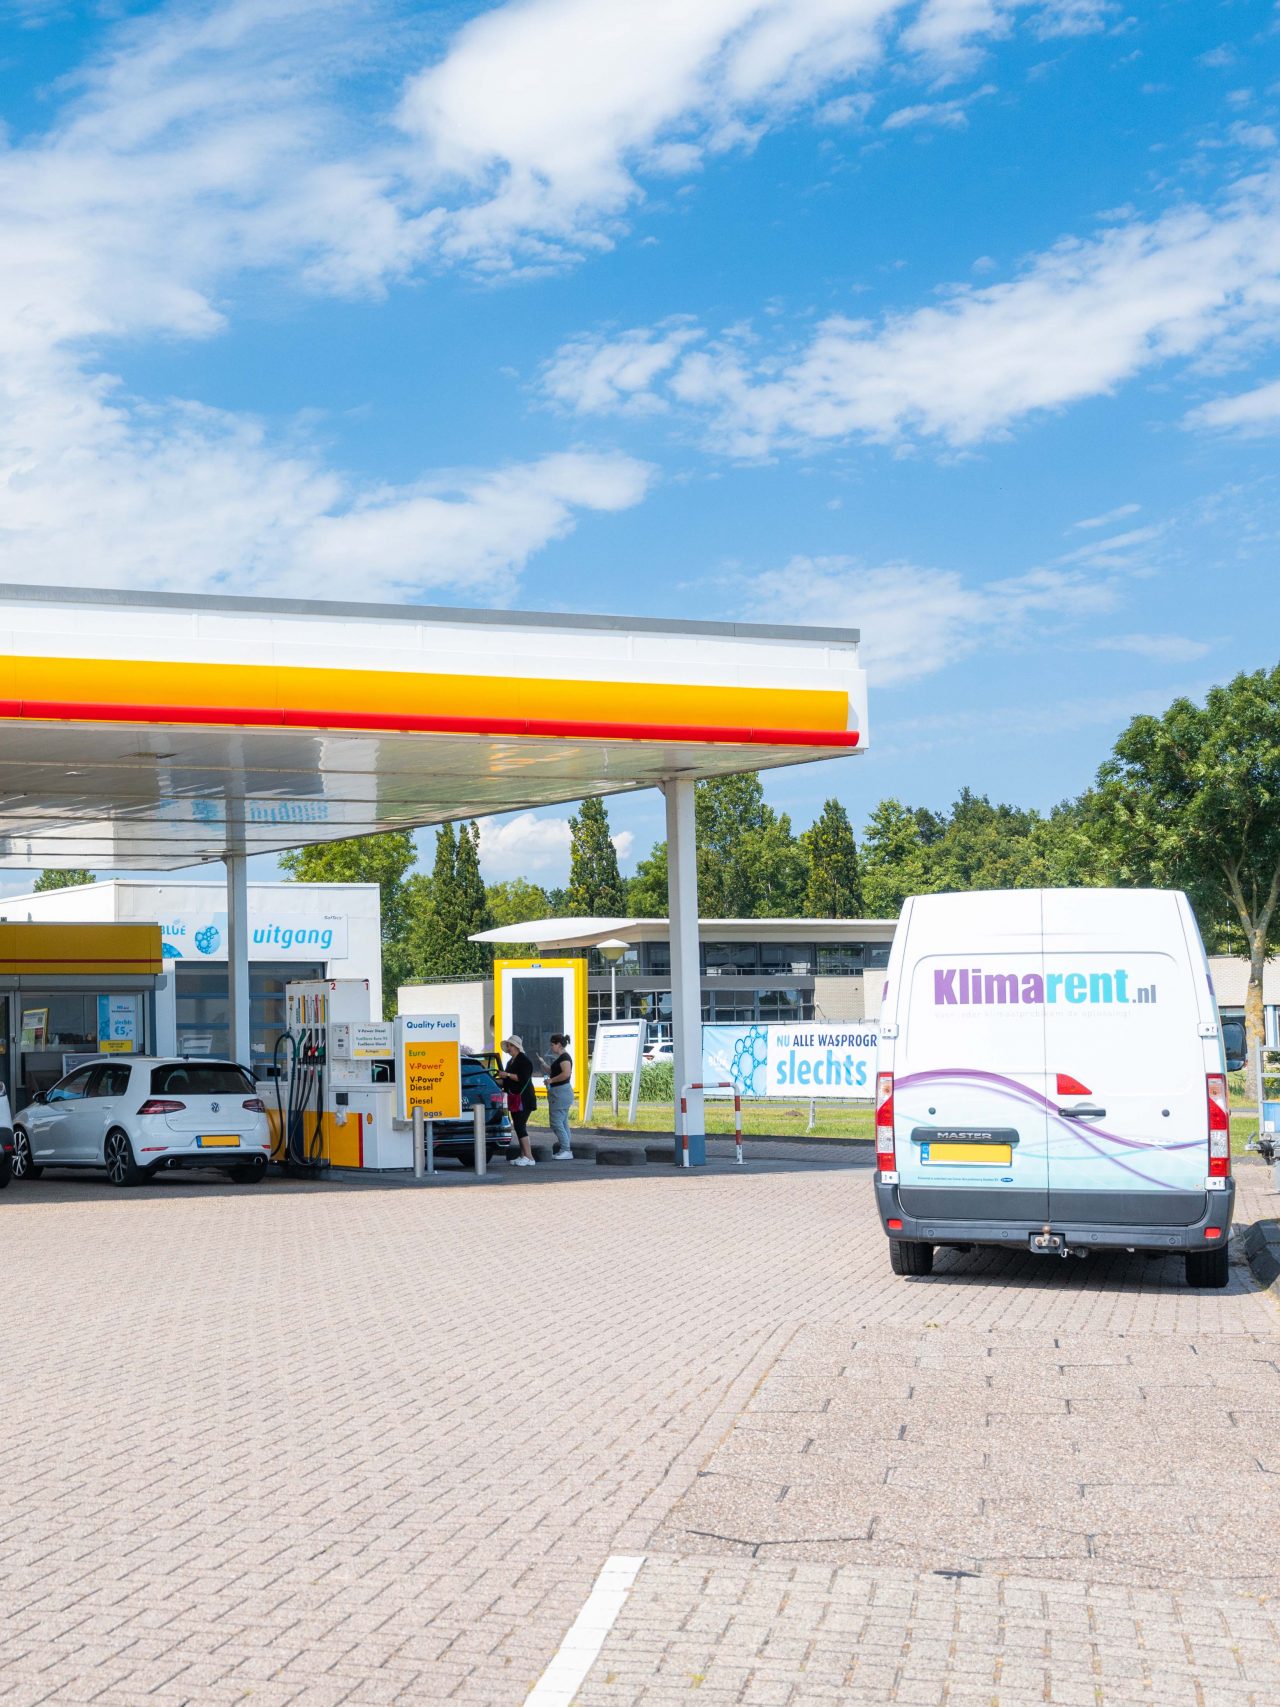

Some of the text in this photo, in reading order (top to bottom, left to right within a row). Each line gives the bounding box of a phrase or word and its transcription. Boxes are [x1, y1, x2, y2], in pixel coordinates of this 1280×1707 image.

[253, 924, 332, 950] uitgang
[934, 968, 1156, 1005] Klimarent.nl
[115, 1026, 132, 1037] €5,-
[406, 1021, 434, 1030] Quality
[776, 1035, 790, 1047] NU
[793, 1035, 814, 1047] ALLE
[776, 1050, 867, 1086] slechts
